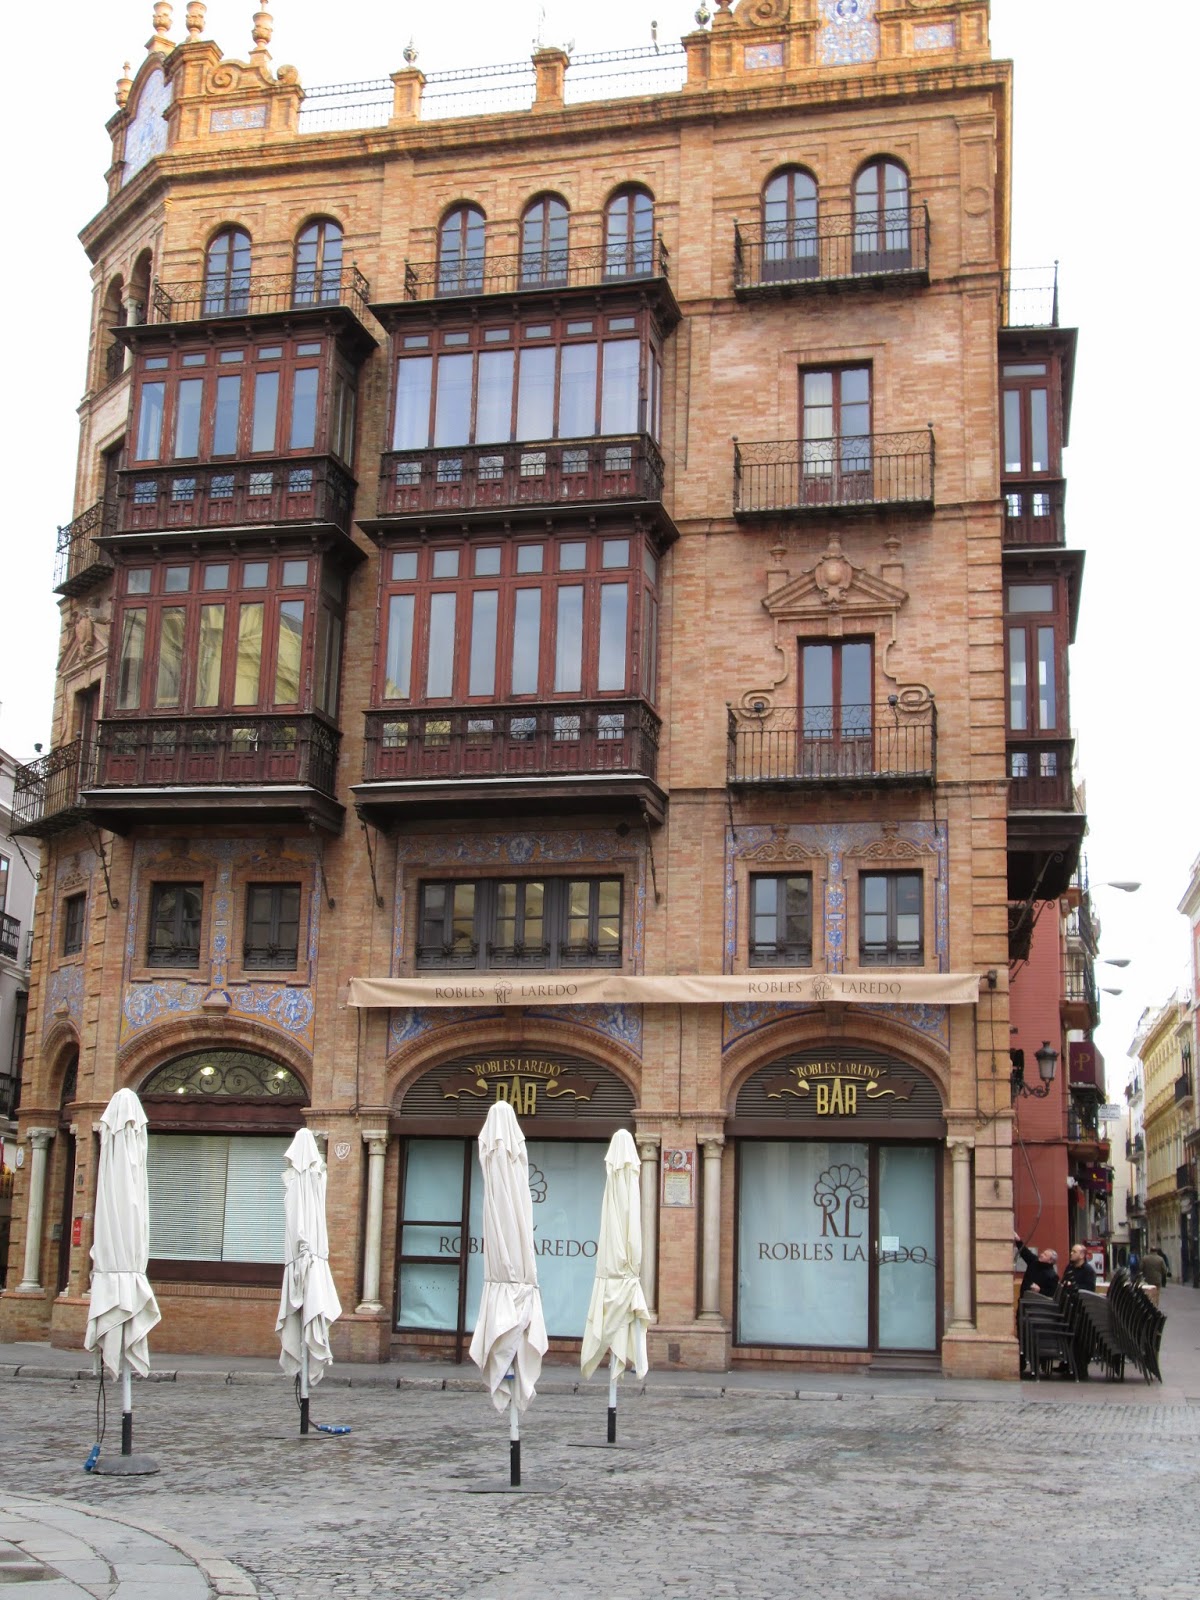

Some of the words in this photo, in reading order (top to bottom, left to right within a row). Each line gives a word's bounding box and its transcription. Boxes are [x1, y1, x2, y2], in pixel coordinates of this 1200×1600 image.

[435, 987, 485, 999] ROBLES
[521, 984, 578, 997] LAREDO
[748, 982, 802, 994] ROBLES
[841, 982, 902, 994] LAREDO
[475, 1059, 516, 1077] ROBLES
[517, 1059, 560, 1077] LAREDO
[796, 1062, 836, 1078] ROBLES
[838, 1062, 880, 1079] LAREDO
[816, 1079, 857, 1115] BAR
[758, 1242, 833, 1261] ROBLES
